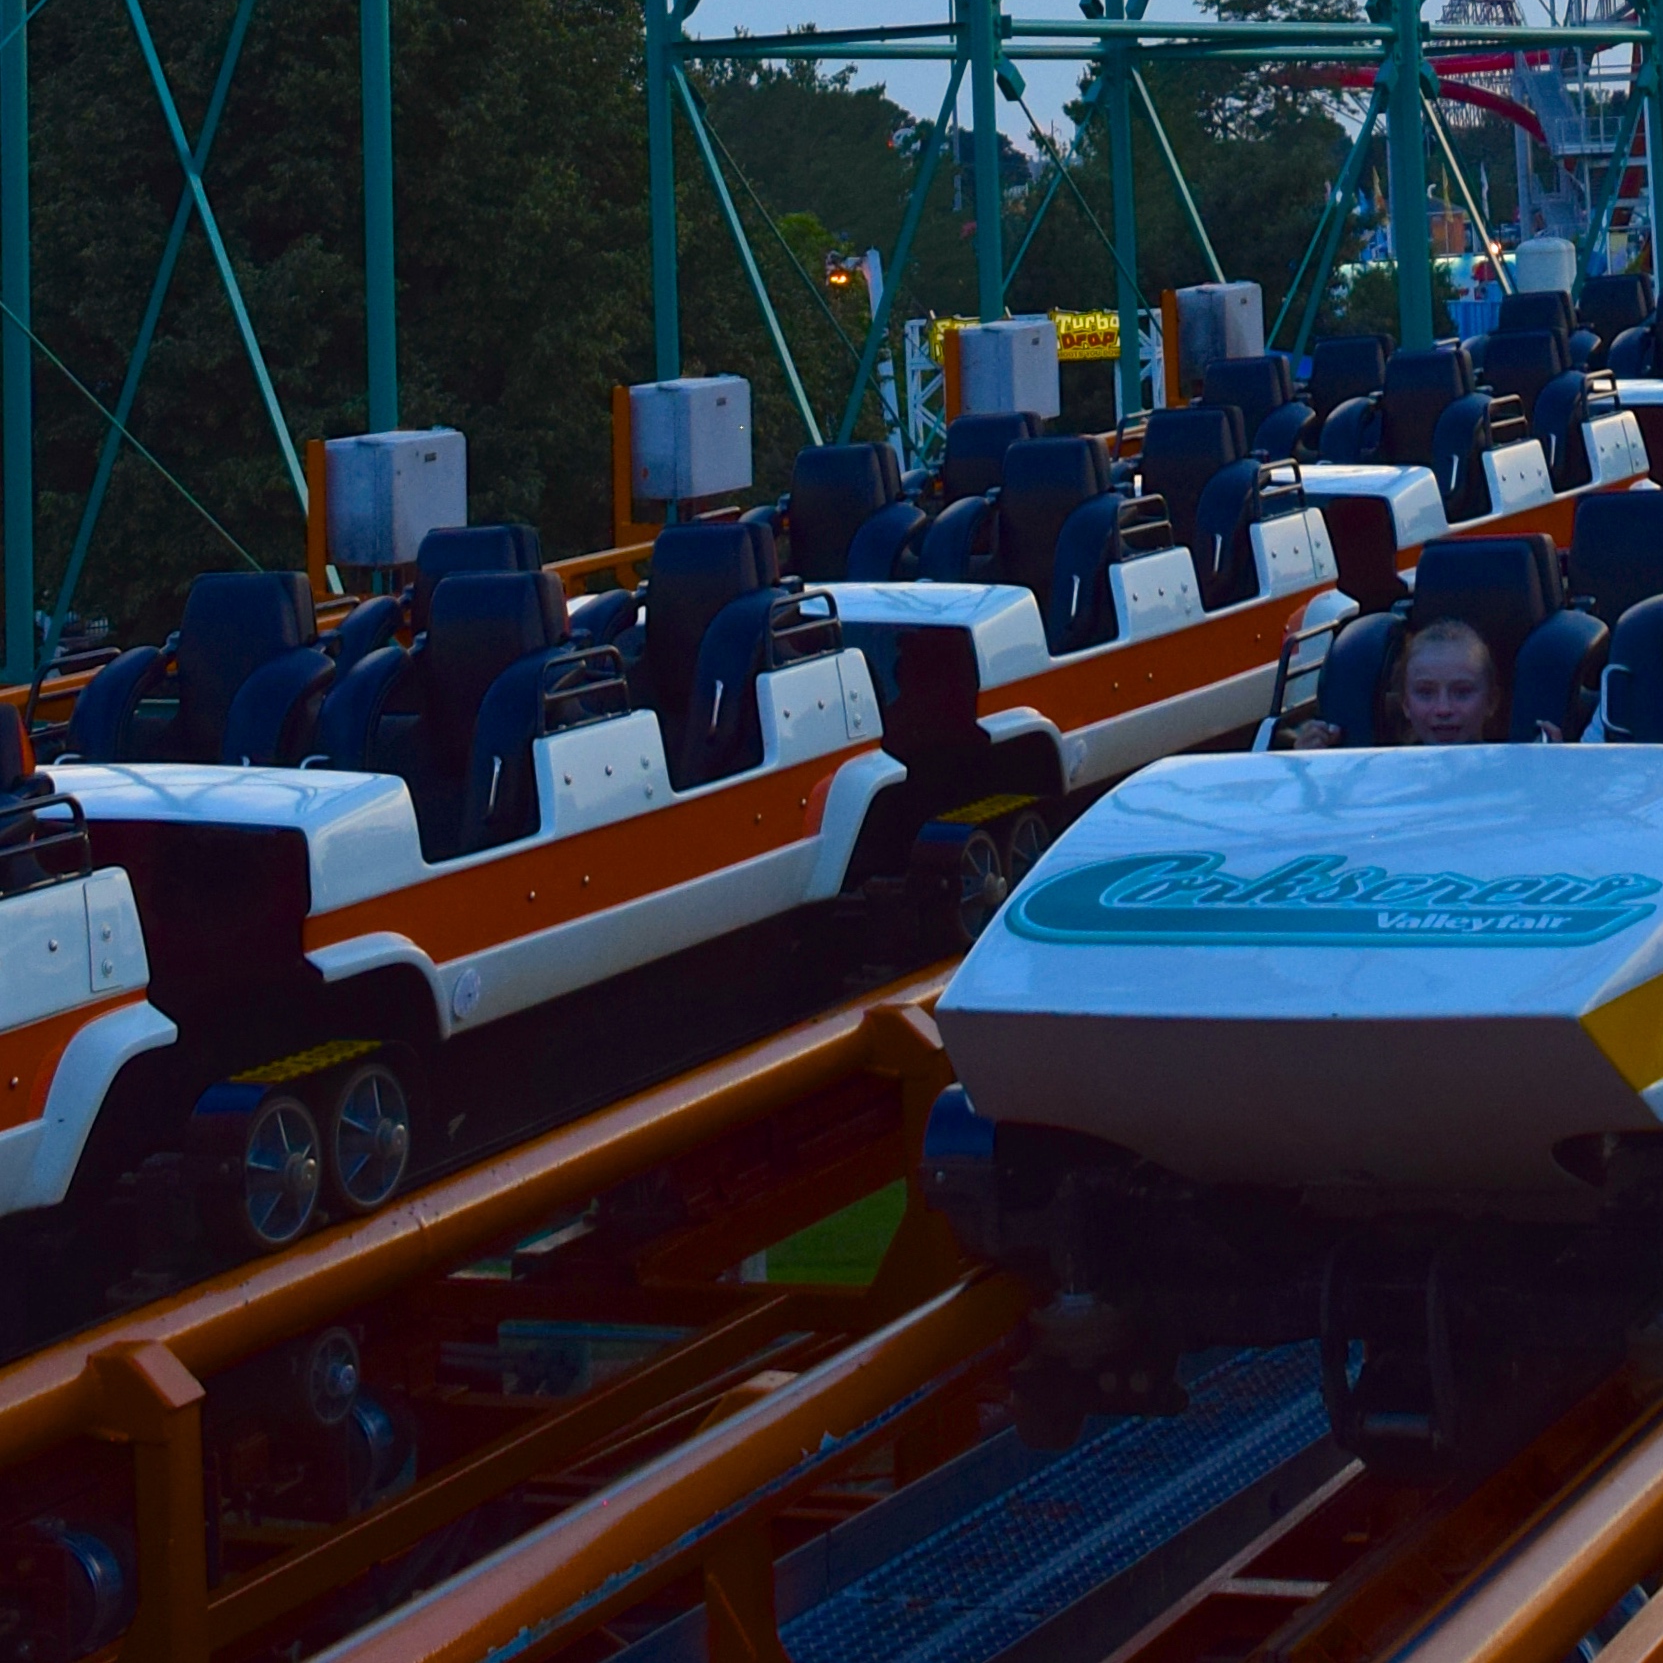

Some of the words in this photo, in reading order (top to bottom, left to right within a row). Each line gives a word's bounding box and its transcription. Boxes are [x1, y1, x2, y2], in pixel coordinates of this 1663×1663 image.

[1056, 314, 1119, 333] Turbo
[1006, 850, 1662, 942] Corkscrew
[1378, 912, 1572, 932] Valleyfair
